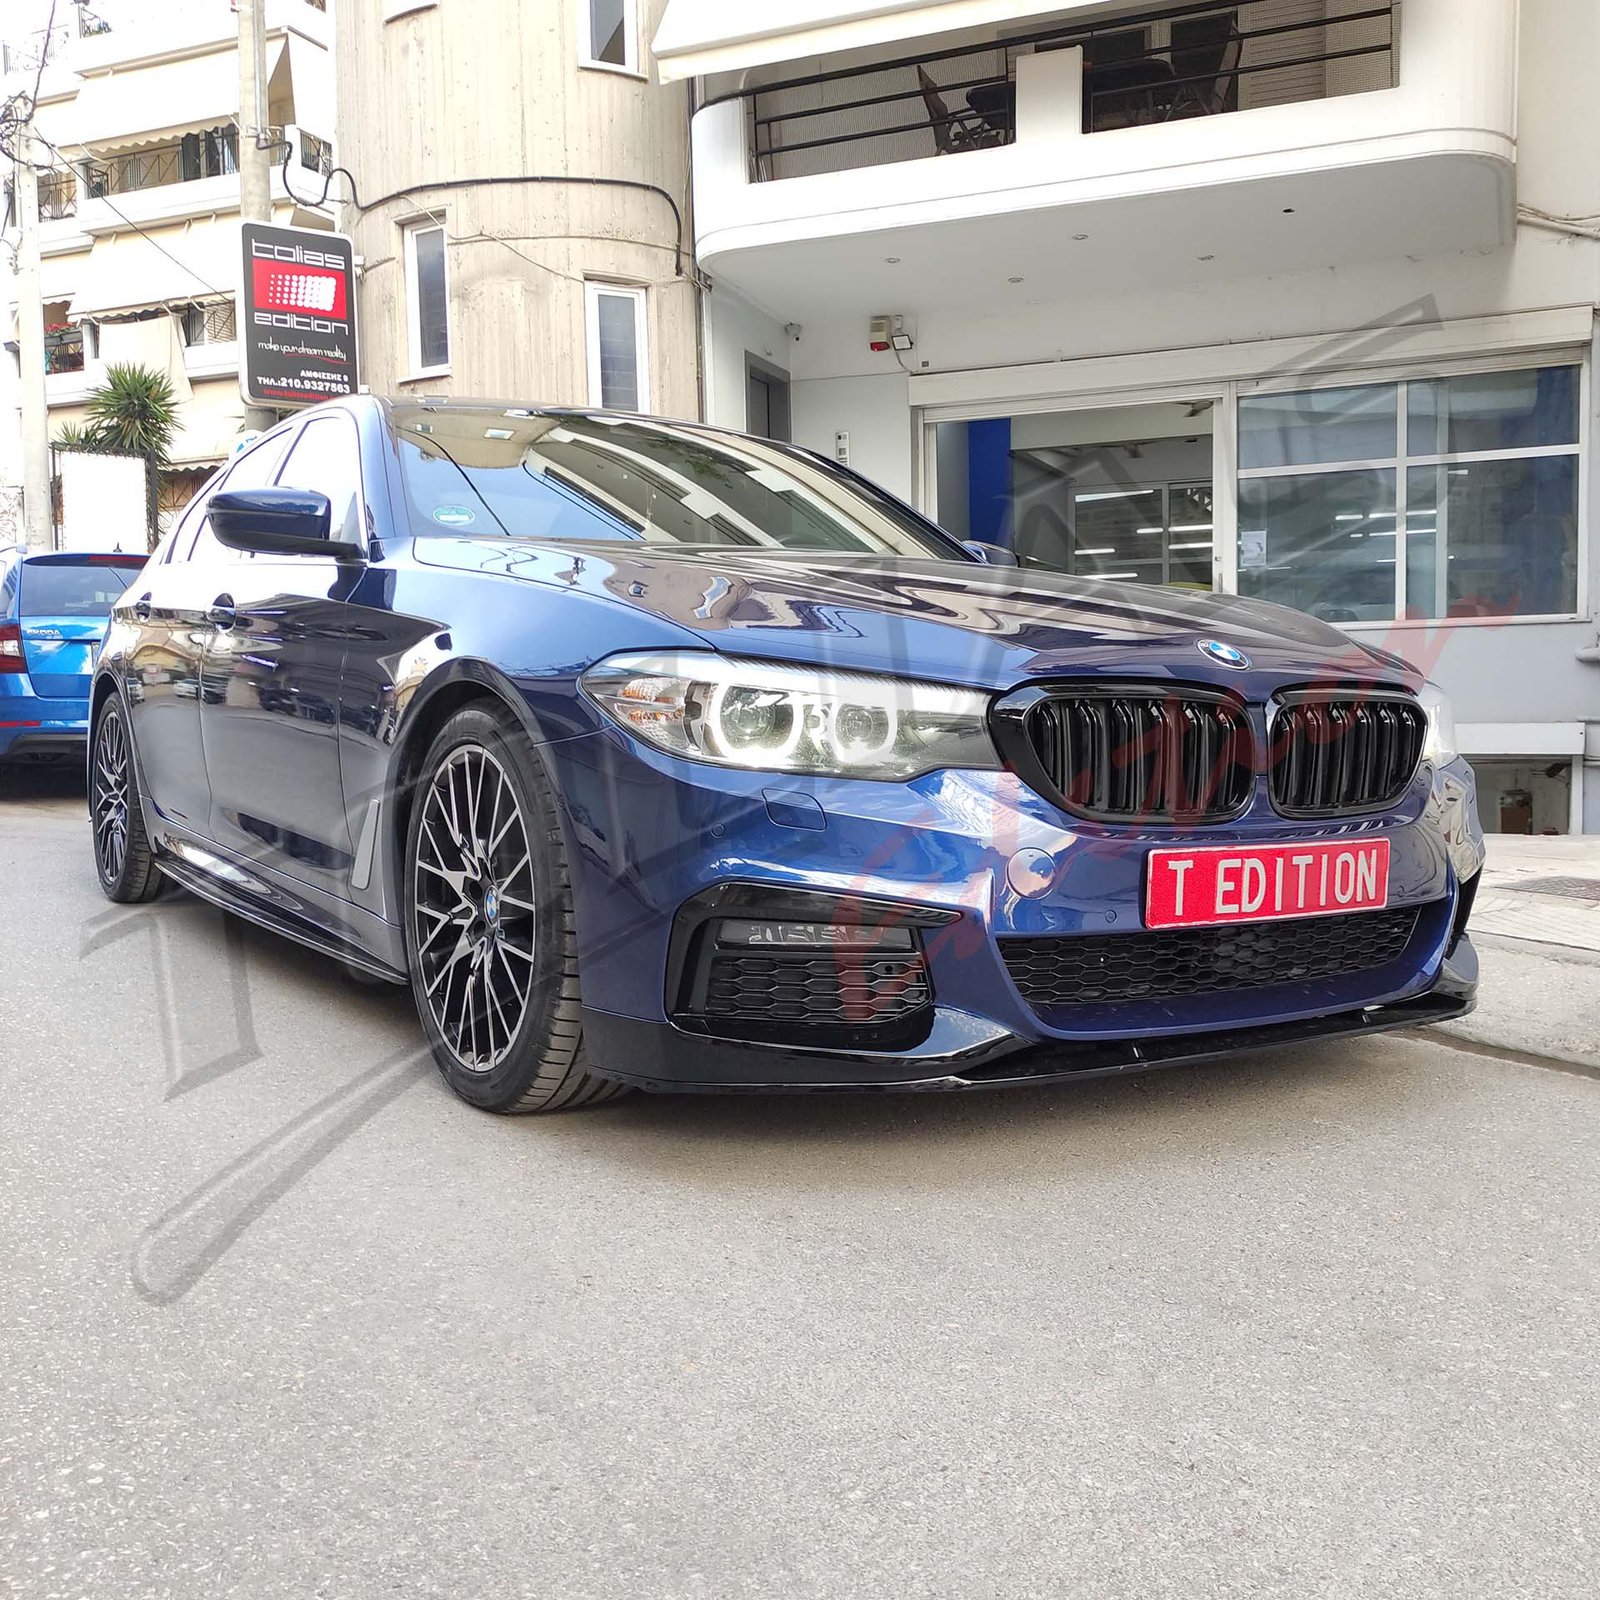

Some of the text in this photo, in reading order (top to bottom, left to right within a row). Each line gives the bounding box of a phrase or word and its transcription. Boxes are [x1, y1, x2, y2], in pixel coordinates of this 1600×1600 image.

[252, 238, 345, 270] tolias
[254, 311, 349, 336] edition
[258, 336, 347, 362] make your dream reality
[1167, 848, 1378, 916] T EDITION
